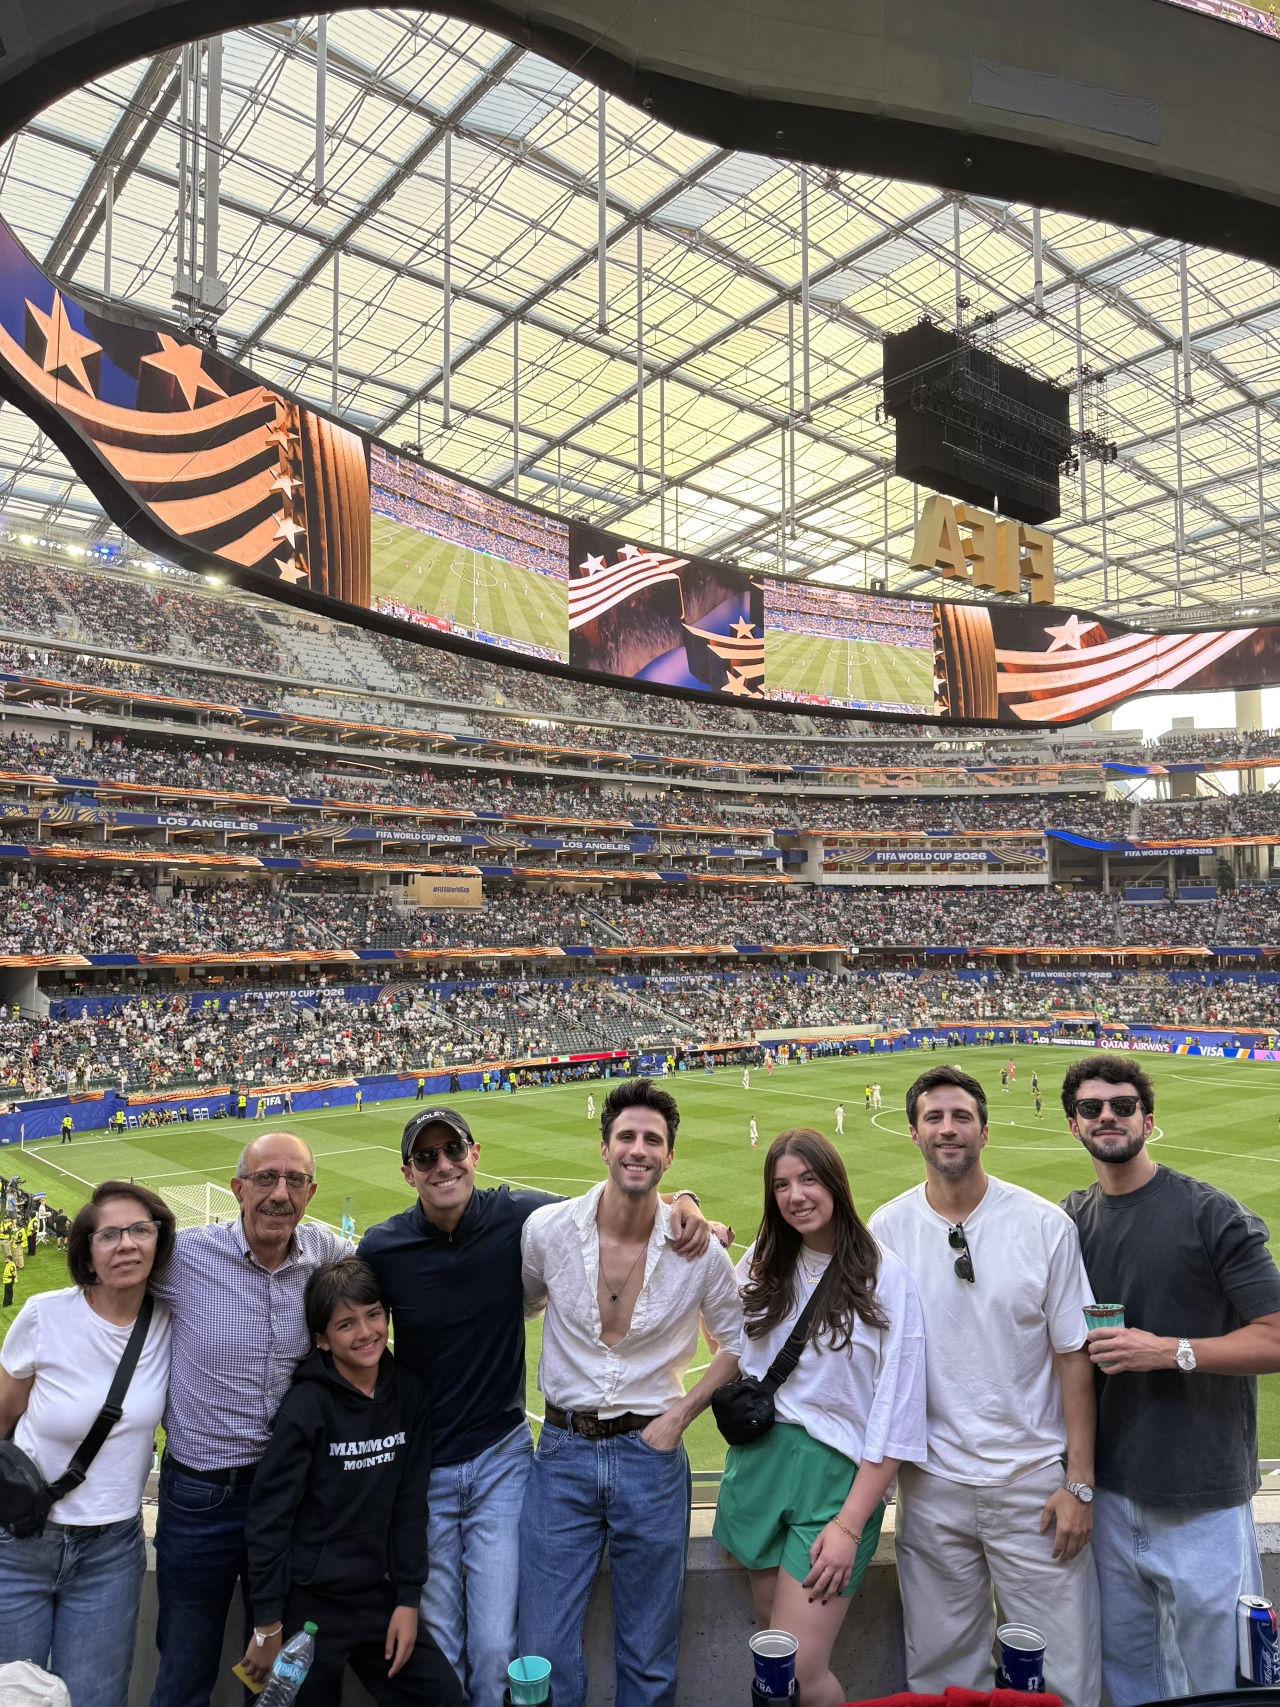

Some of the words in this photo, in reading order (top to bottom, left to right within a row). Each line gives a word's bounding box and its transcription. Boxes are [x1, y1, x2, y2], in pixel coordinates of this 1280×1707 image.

[158, 816, 188, 826] LOS
[190, 819, 258, 831] ANGELES
[393, 832, 420, 840] WORLD
[584, 842, 630, 851] ANGELES
[298, 989, 315, 998] CUP
[1101, 1040, 1130, 1050] QATAR
[1132, 1041, 1170, 1053] AIRWAYS
[1198, 1046, 1224, 1057] VISA
[755, 1678, 774, 1694] TRA
